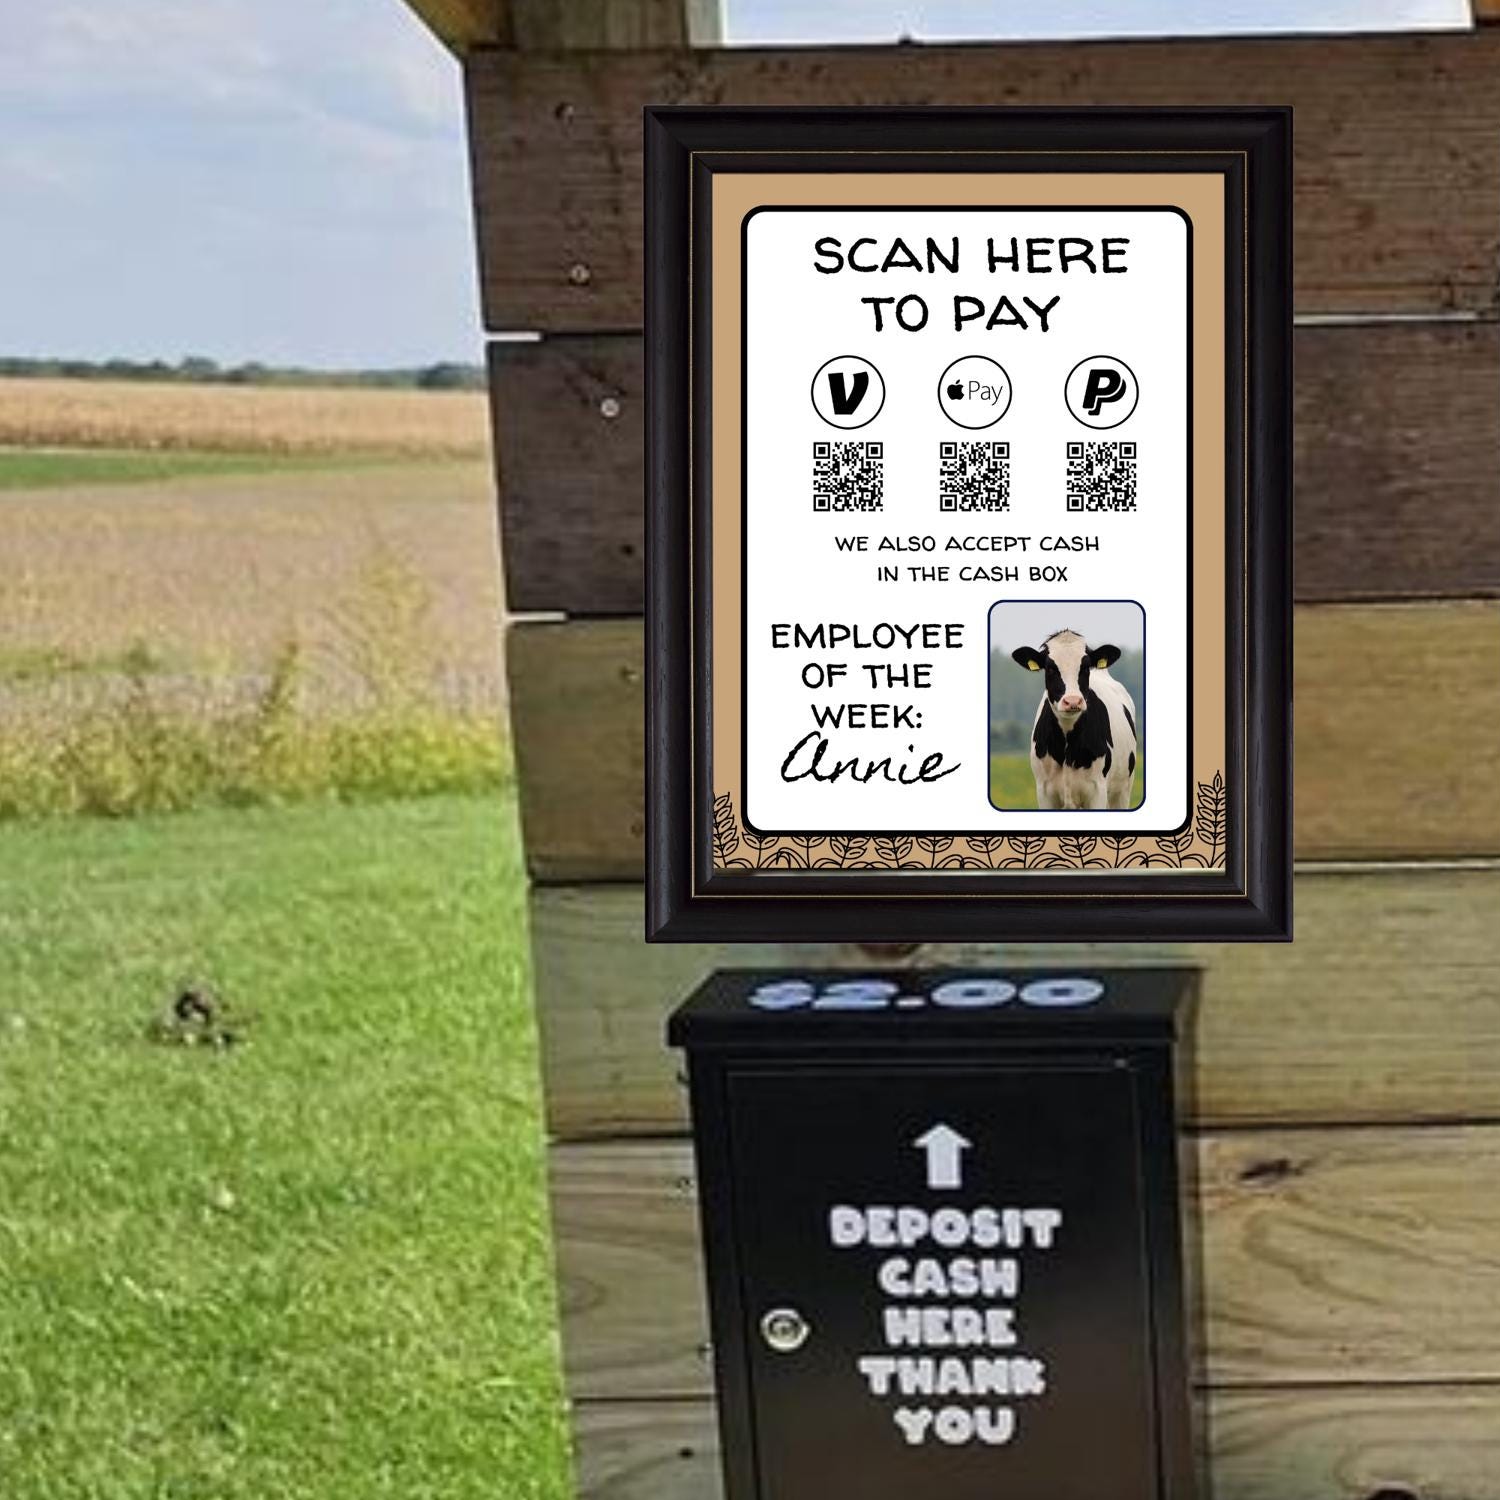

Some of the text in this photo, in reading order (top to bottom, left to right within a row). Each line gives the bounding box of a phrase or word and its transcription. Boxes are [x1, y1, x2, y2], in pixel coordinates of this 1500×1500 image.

[814, 237, 1130, 274] SCAN HERE
[861, 294, 1060, 332] TO PAY
[969, 381, 1003, 405] Pay
[835, 536, 1099, 551] WE ALSO ACCEPT CASH
[878, 566, 1067, 581] IN THE CASH BOX
[772, 623, 964, 649] EMPLOYEE
[802, 663, 933, 688] OF THE
[811, 704, 922, 728] WEEK:
[780, 730, 962, 785] Annie
[831, 1206, 1061, 1248] DEPOSIT
[879, 1258, 1018, 1297] CASH
[884, 1307, 1017, 1346] HERE
[858, 1357, 1045, 1395] THANK
[894, 1406, 1014, 1444] YOU
